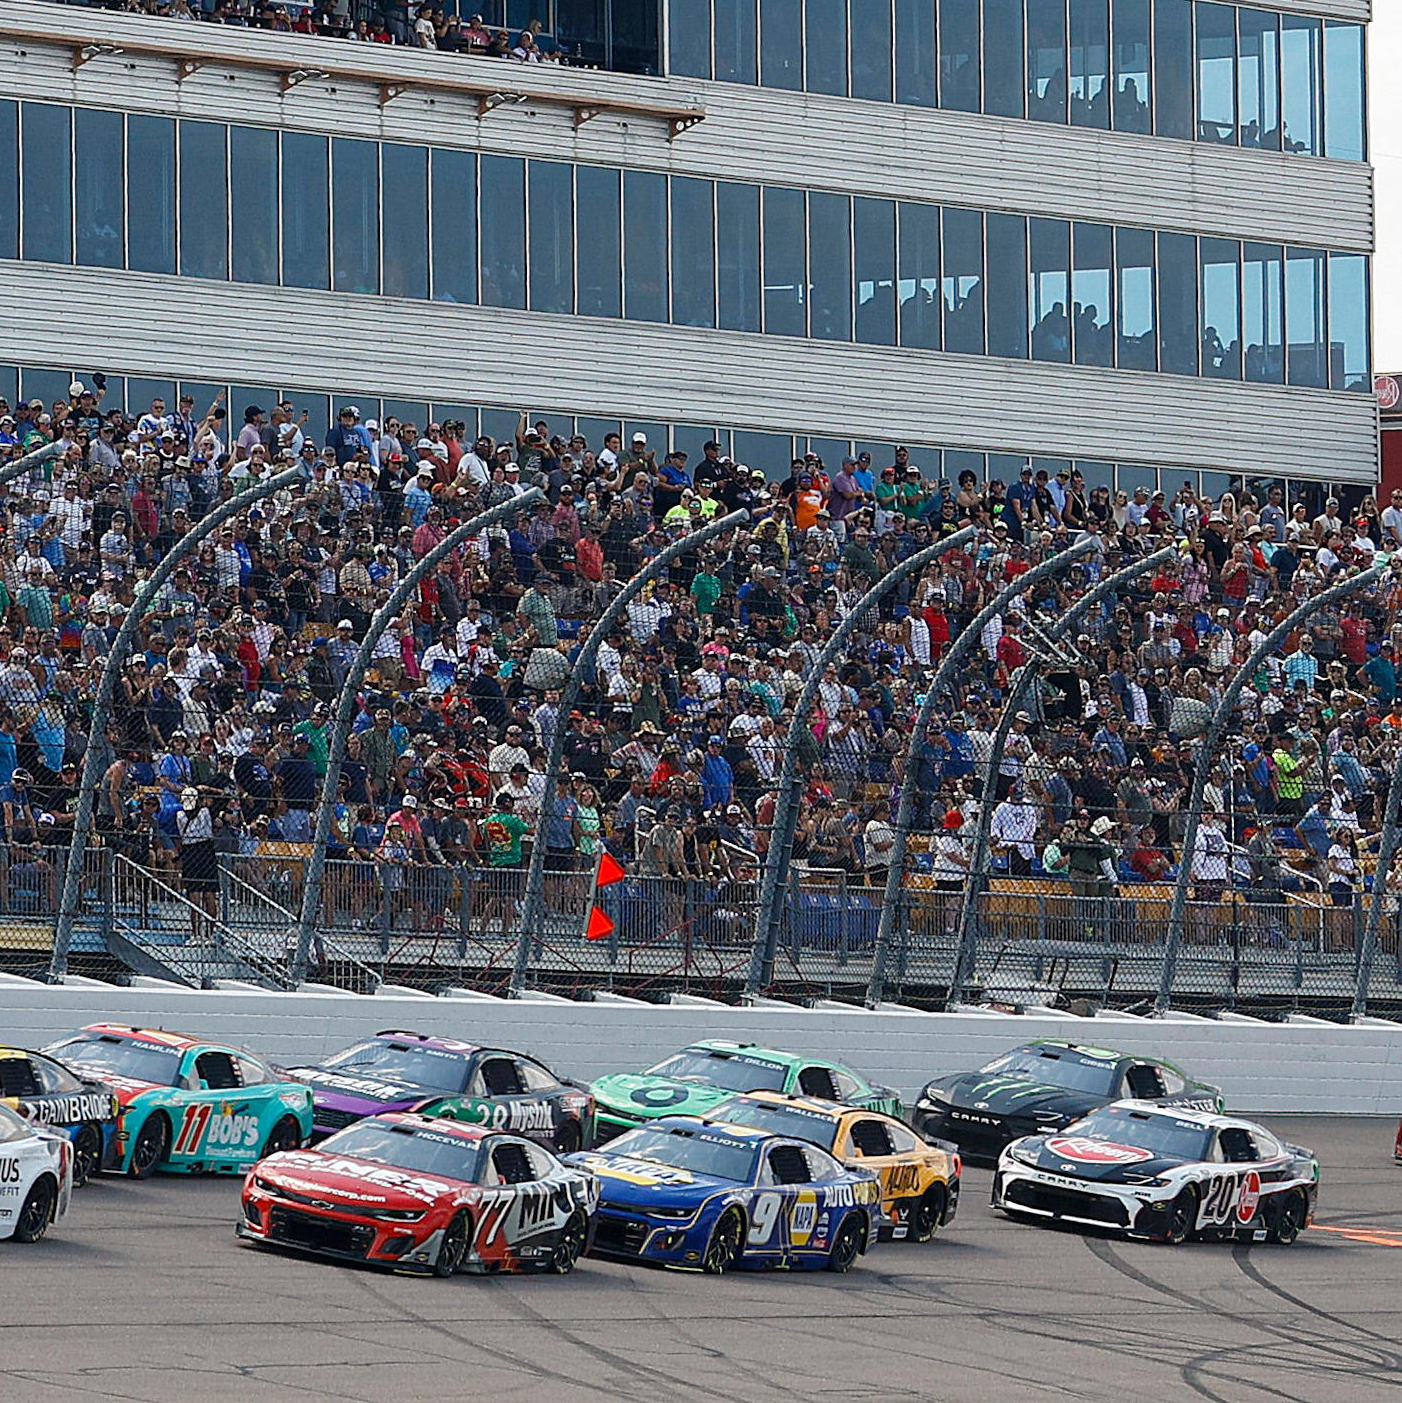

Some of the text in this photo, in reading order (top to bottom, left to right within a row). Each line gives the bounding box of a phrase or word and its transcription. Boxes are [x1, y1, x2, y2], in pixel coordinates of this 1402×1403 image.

[131, 1040, 179, 1056] HAMLIN
[744, 1057, 784, 1071] DILLON
[39, 1095, 112, 1125] GAINBRIDGE
[510, 1101, 554, 1131] Mystik
[951, 1111, 1001, 1126] CAMRY
[173, 1102, 213, 1155] 11
[207, 1114, 259, 1146] BOB'S
[1175, 1120, 1203, 1131] BELL
[417, 1131, 475, 1149] HOCEVAR
[699, 1134, 746, 1149] ELLIOTT
[1037, 1173, 1090, 1189] CAMRY
[823, 1185, 853, 1208] AUTO
[1202, 1172, 1238, 1224] 20
[472, 1190, 516, 1247] 77
[747, 1192, 783, 1245] 9
[795, 1204, 815, 1230] NAPA
